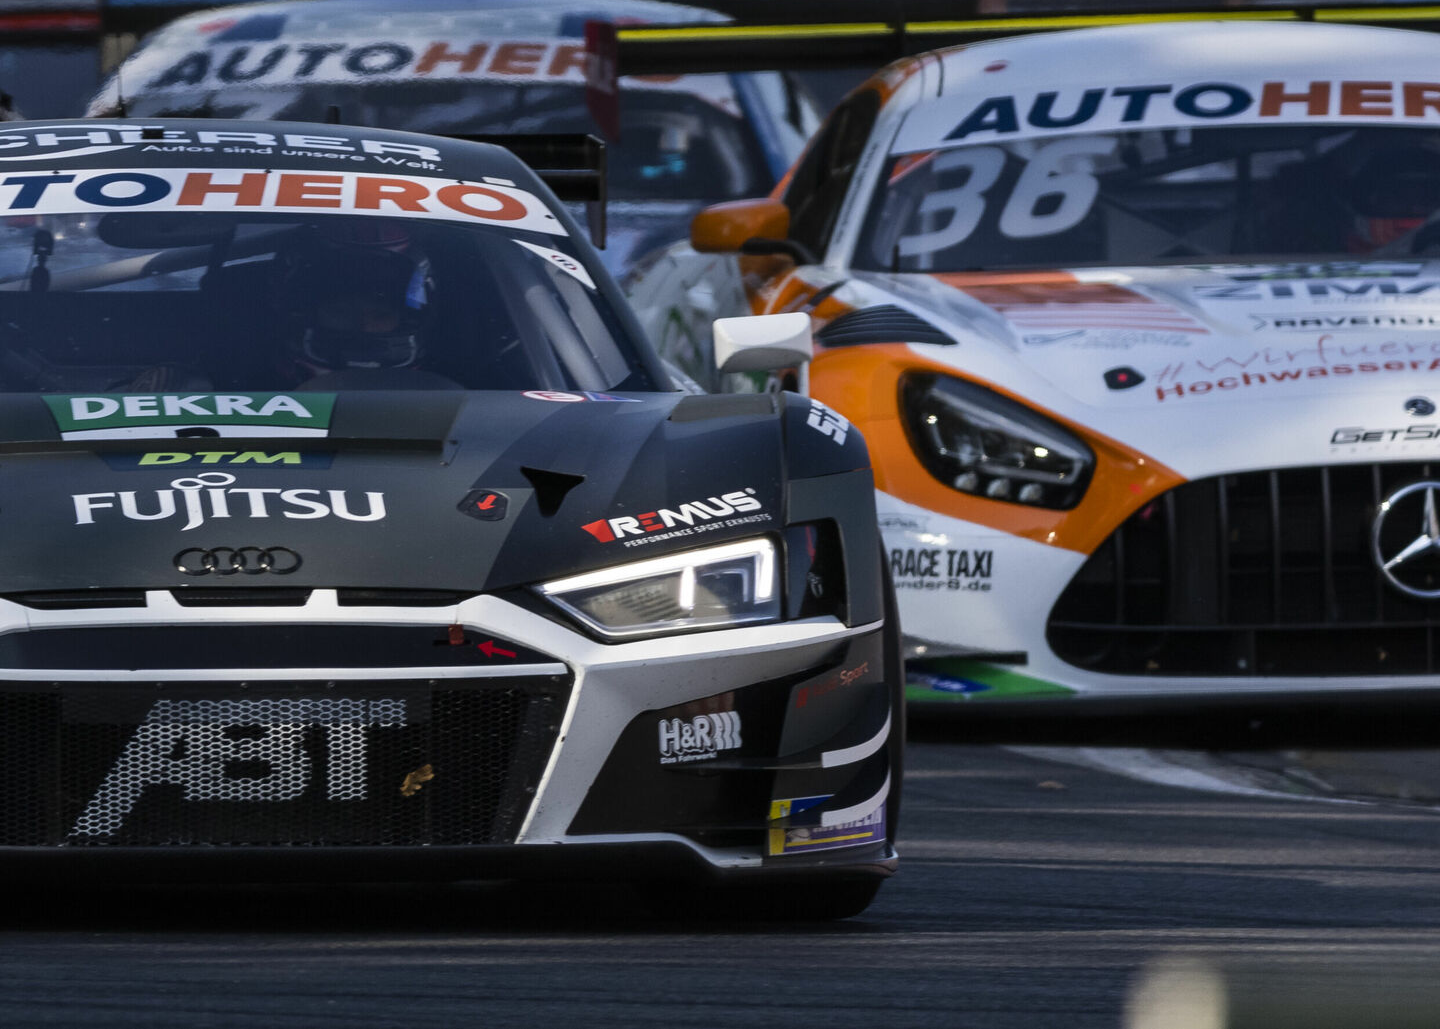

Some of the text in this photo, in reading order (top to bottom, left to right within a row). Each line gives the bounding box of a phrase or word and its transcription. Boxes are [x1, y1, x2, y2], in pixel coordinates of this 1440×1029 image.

[142, 144, 444, 171] Autos sind unsere Welt.
[899, 137, 1118, 256] 36
[69, 396, 313, 420] DEKRA
[138, 452, 302, 465] DTM
[71, 472, 387, 531] FUJITSU
[609, 491, 762, 539] REMUS
[624, 513, 772, 548] PERFORMANCE SPORT EXHAUSTS
[890, 549, 994, 578] RACE TAXI
[659, 715, 715, 756] H&R
[66, 698, 407, 837] ABT
